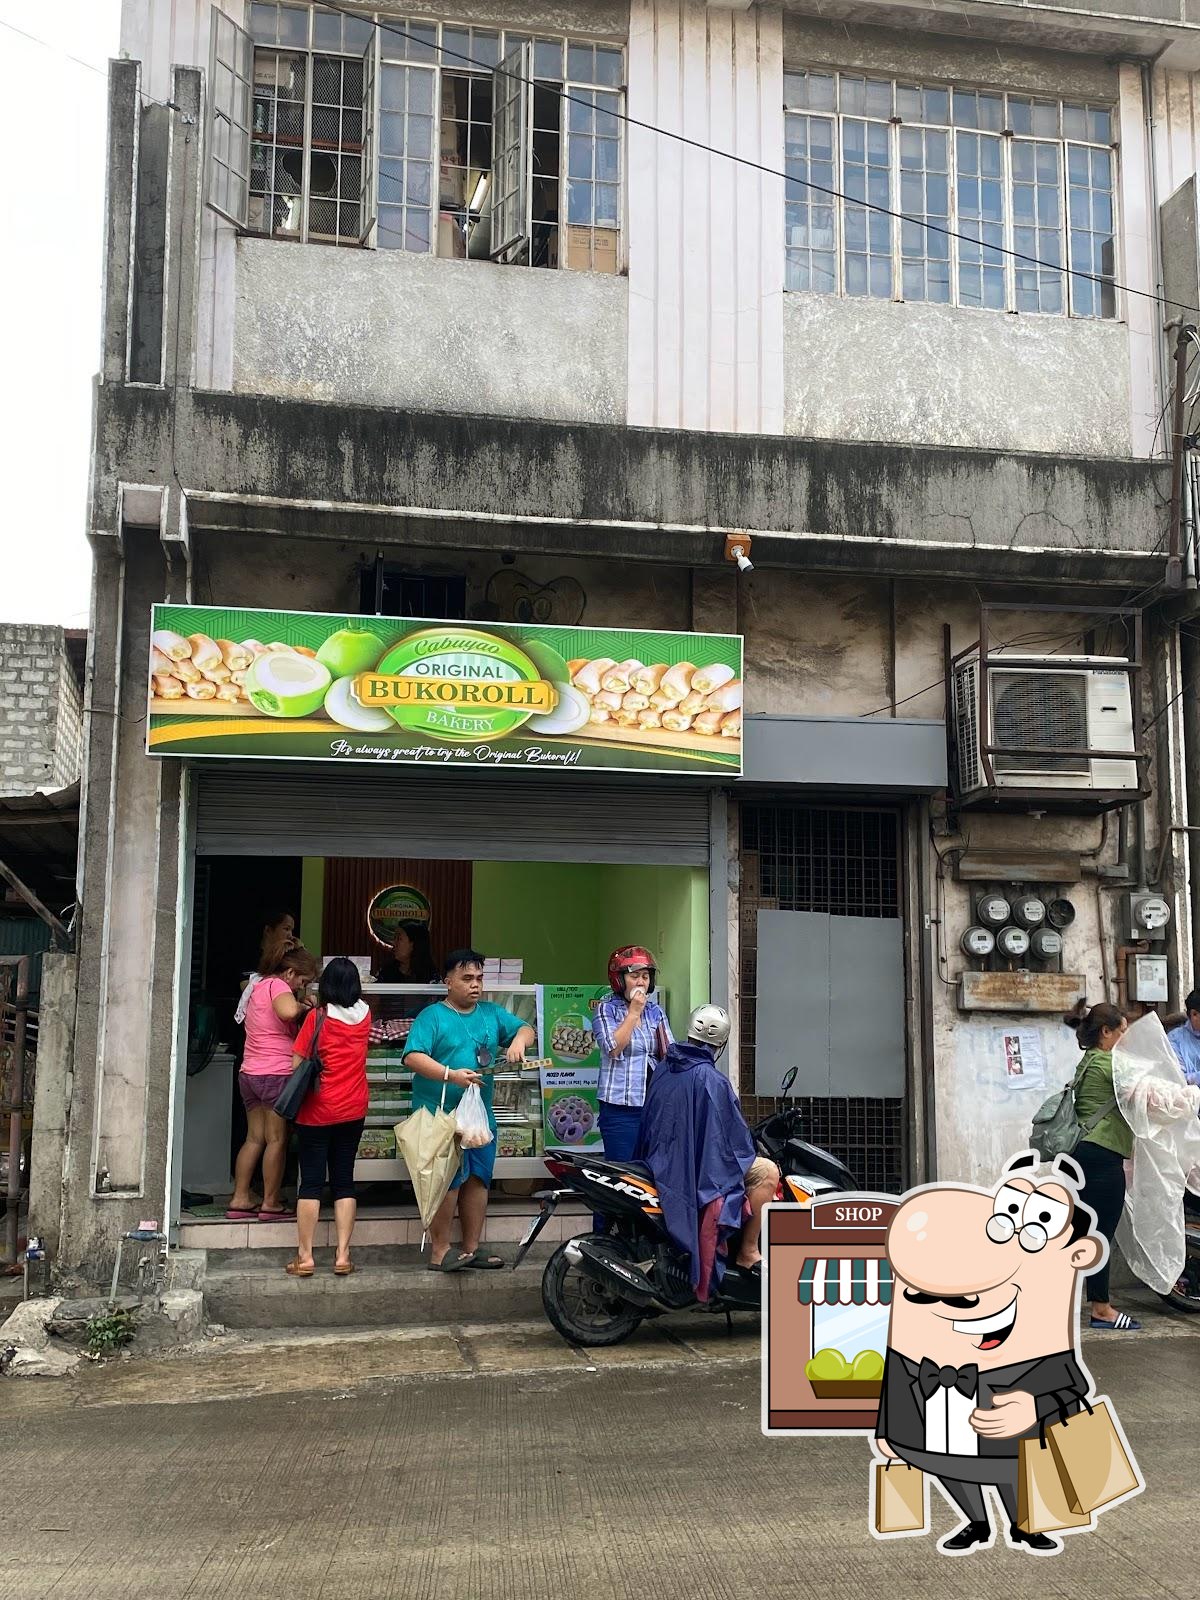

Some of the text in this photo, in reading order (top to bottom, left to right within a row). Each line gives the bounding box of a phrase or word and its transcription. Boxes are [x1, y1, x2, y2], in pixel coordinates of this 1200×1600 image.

[414, 637, 500, 656] Cabuyao
[415, 662, 503, 679] ORIGINAL
[368, 679, 544, 705] BUKOROLL
[426, 710, 496, 731] BAKERY
[355, 744, 392, 760] always
[391, 745, 427, 761] great
[424, 747, 437, 756] to
[436, 748, 454, 762] try
[451, 747, 471, 758] the
[473, 744, 522, 764] Original
[524, 746, 582, 766] Bukoroll!
[581, 1168, 660, 1208] CLICK
